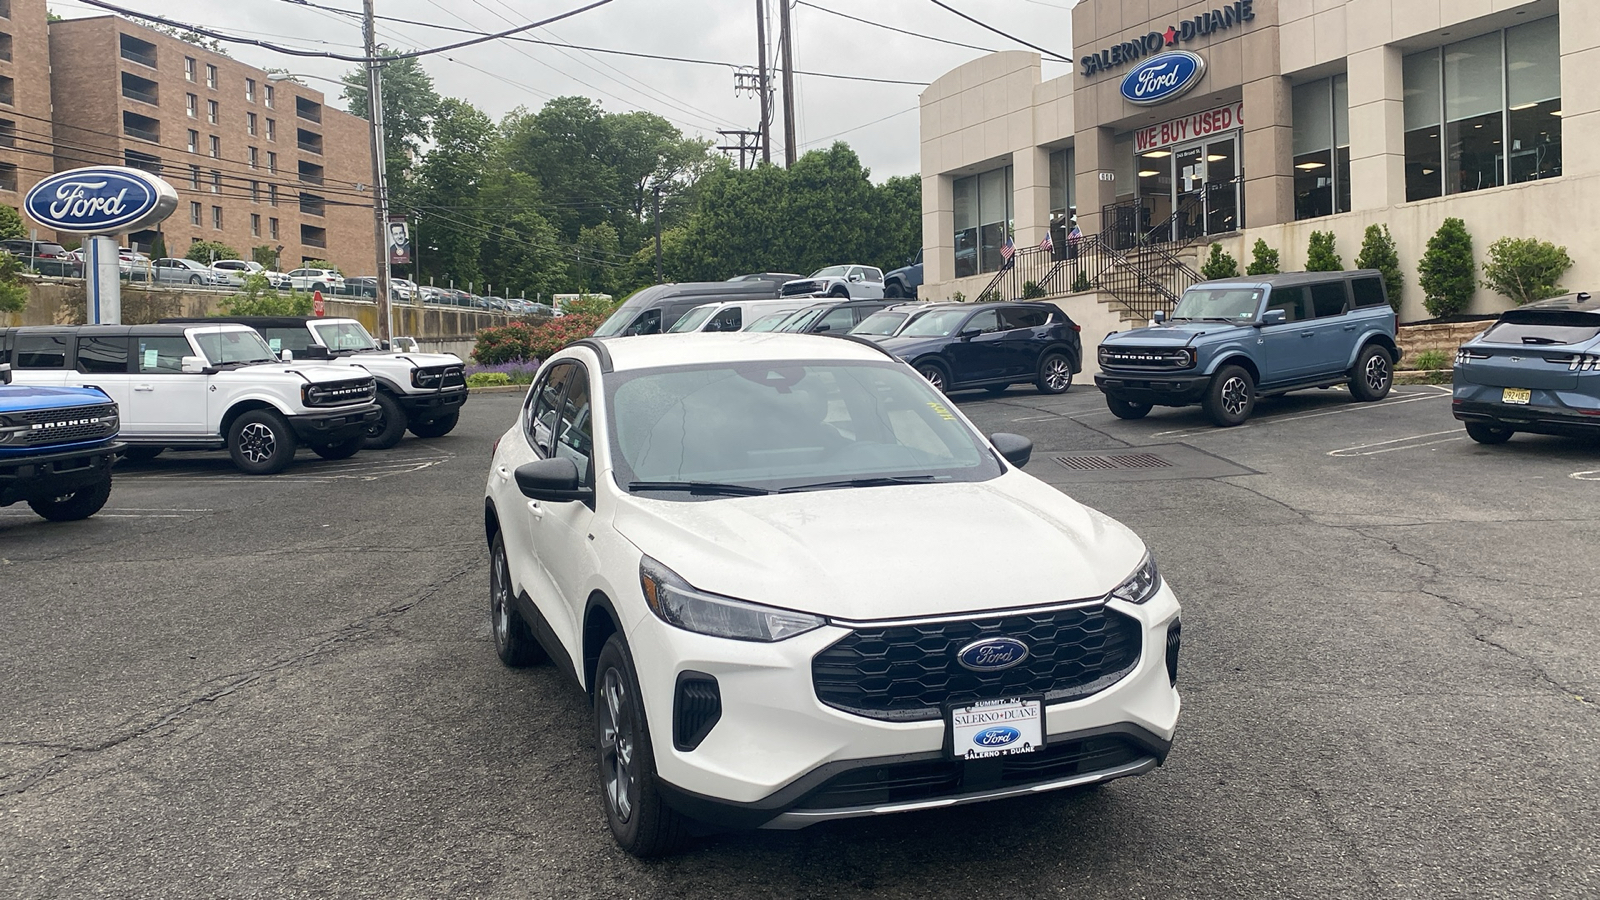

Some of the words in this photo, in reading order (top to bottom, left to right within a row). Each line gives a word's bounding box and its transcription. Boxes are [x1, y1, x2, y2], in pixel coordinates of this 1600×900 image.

[1080, 31, 1163, 77] SALERNO
[1180, 0, 1255, 41] DUANE
[1134, 62, 1179, 97] Ford
[1136, 127, 1157, 150] WE
[1161, 118, 1189, 144] BUY
[1193, 107, 1232, 136] USED
[49, 181, 128, 219] Ford
[332, 387, 368, 395] BRONCO
[31, 417, 99, 430] BRONCO
[976, 645, 1014, 665] Ford
[954, 711, 999, 726] SALERNO
[1004, 707, 1037, 720] DUANE
[982, 729, 1011, 745] Ford
[964, 749, 1000, 760] SALERNO
[1010, 746, 1035, 755] DUANE
